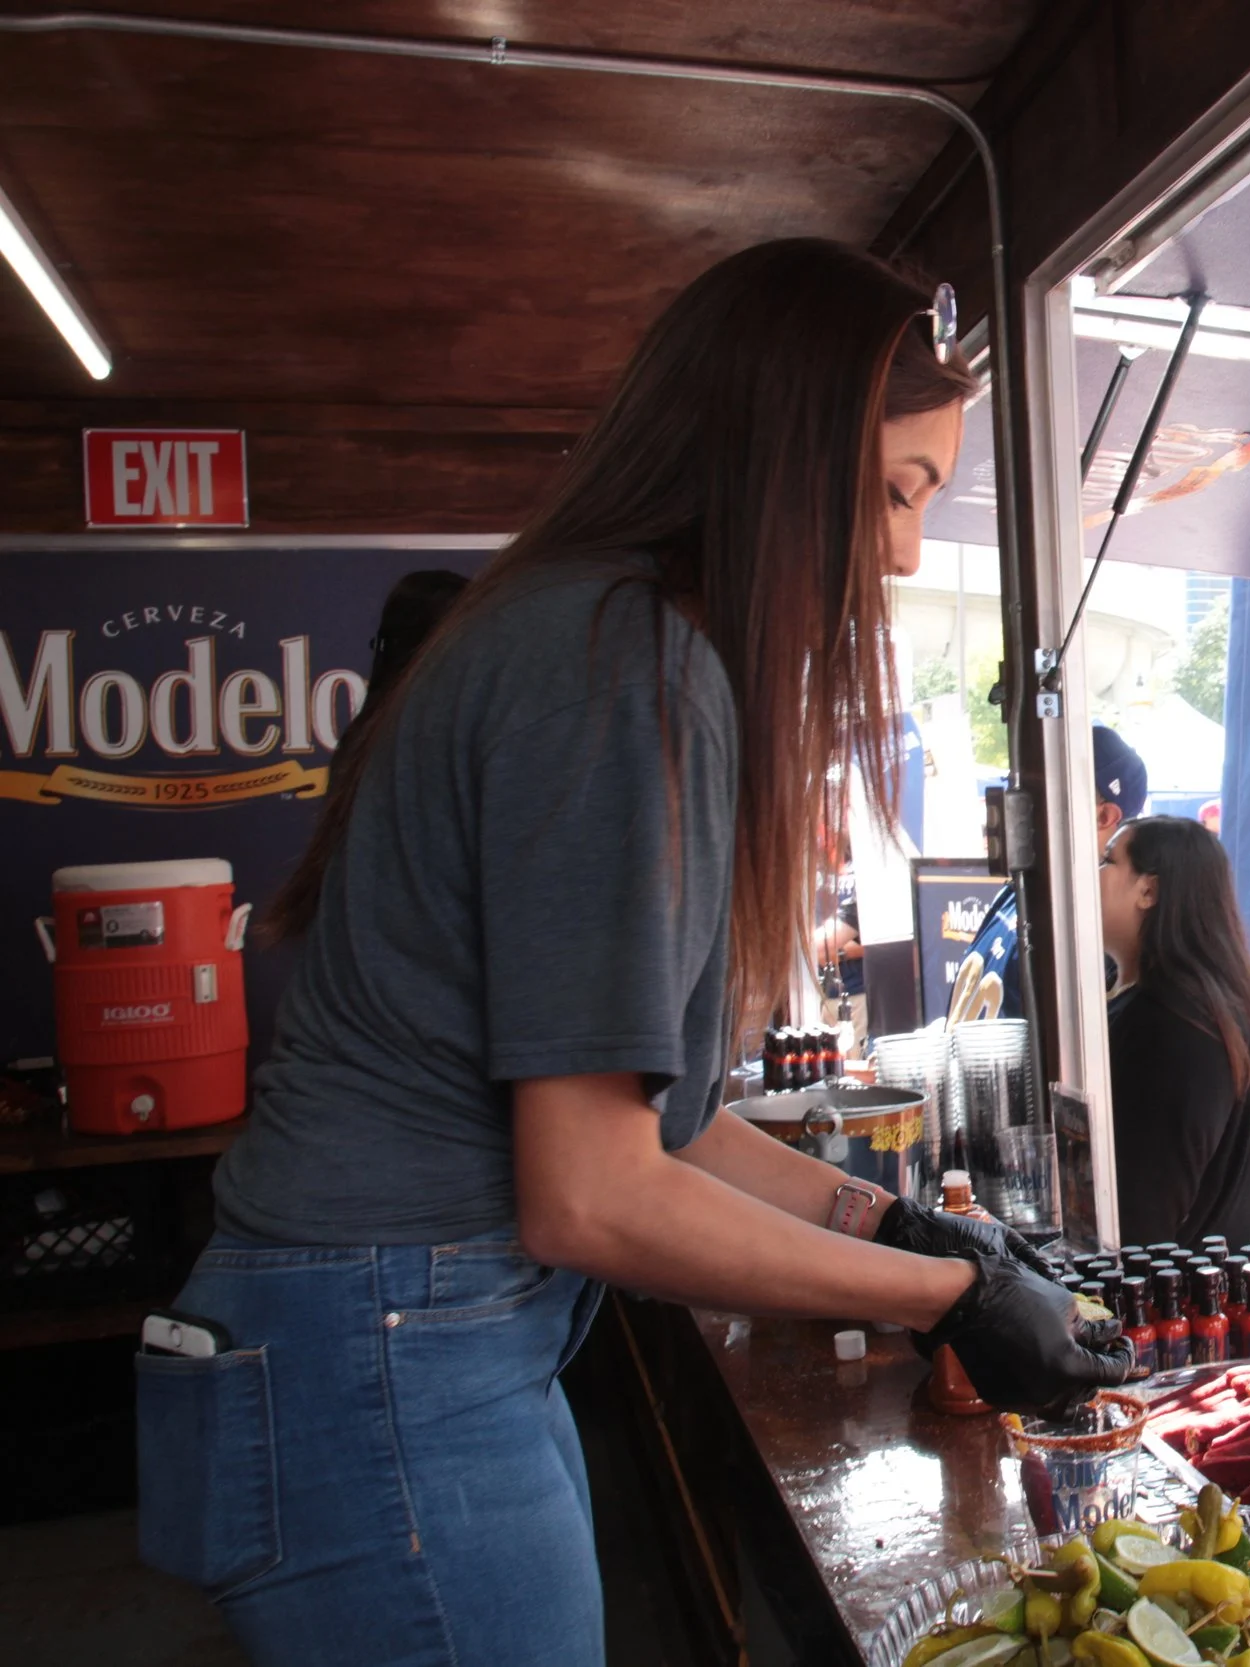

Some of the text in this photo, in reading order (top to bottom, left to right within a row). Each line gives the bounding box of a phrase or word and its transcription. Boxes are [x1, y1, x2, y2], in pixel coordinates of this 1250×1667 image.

[111, 441, 219, 517] EXIT
[101, 604, 246, 639] CERVEZA
[0, 629, 368, 758] Modelo
[154, 782, 210, 800] 1925
[103, 1002, 170, 1020] IGLOO
